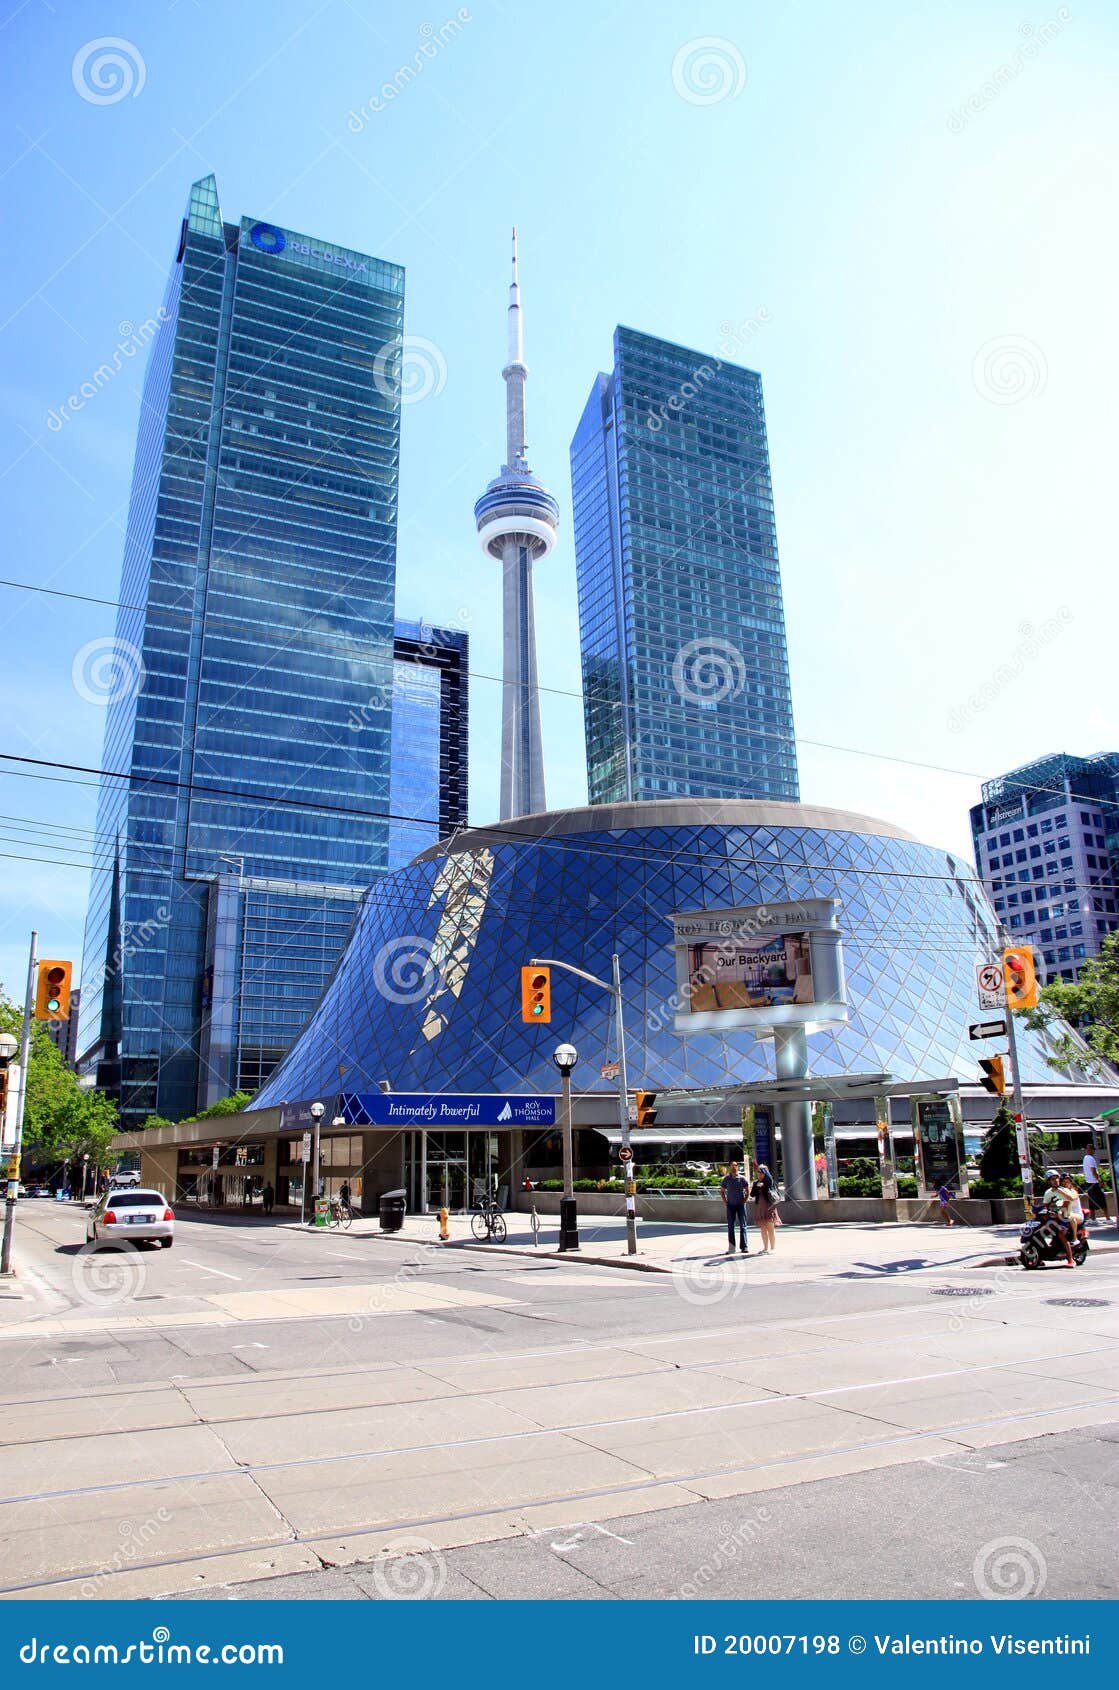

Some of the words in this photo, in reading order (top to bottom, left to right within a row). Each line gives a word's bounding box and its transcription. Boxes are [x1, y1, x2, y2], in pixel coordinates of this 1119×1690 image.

[290, 241, 321, 259] RBC
[324, 251, 367, 273] DEXIA
[717, 957, 736, 967] Our
[739, 952, 788, 965] Backyard
[389, 1103, 438, 1120] Intimately
[440, 1103, 481, 1120] Powerful
[514, 1108, 553, 1116] THOMSON
[525, 1100, 540, 1109] ROY
